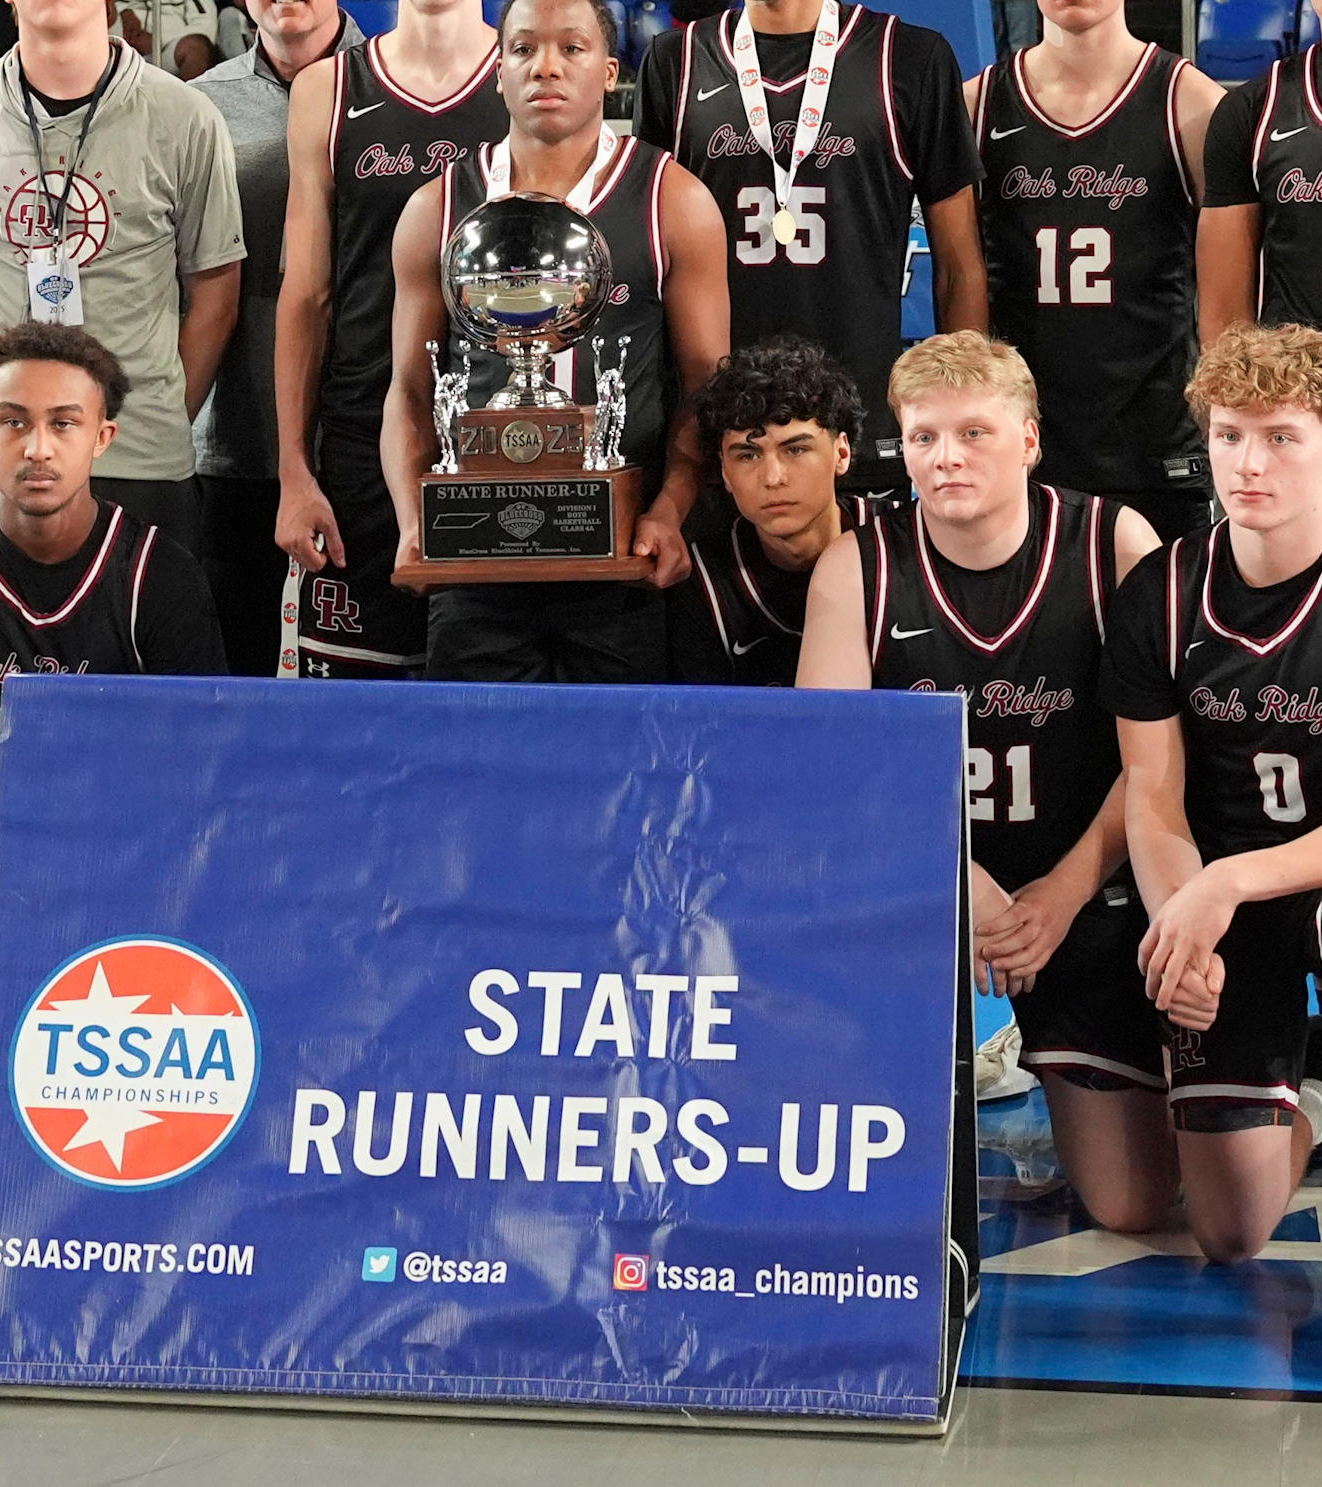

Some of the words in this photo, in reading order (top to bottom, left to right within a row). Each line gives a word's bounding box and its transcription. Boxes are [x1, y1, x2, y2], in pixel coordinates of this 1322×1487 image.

[355, 143, 414, 179] Oak
[1001, 166, 1056, 200] Oak
[1062, 164, 1148, 210] Ridge
[735, 186, 827, 266] 35
[1034, 225, 1114, 305] 12
[505, 433, 541, 448] TSSAA
[437, 485, 491, 500] STATE
[495, 483, 600, 499] RUNNER-UP
[977, 676, 1075, 727] Ridge
[1189, 686, 1248, 724] Oak
[966, 744, 1038, 823] 21
[465, 968, 740, 1062] STATE
[34, 1021, 235, 1082] TSSAA
[41, 1084, 219, 1107] CHAMPIONSHIPS
[288, 1086, 906, 1193] RUNNERS-UP
[402, 1251, 508, 1287] @tssaa
[656, 1260, 919, 1301] tssaa_champions
